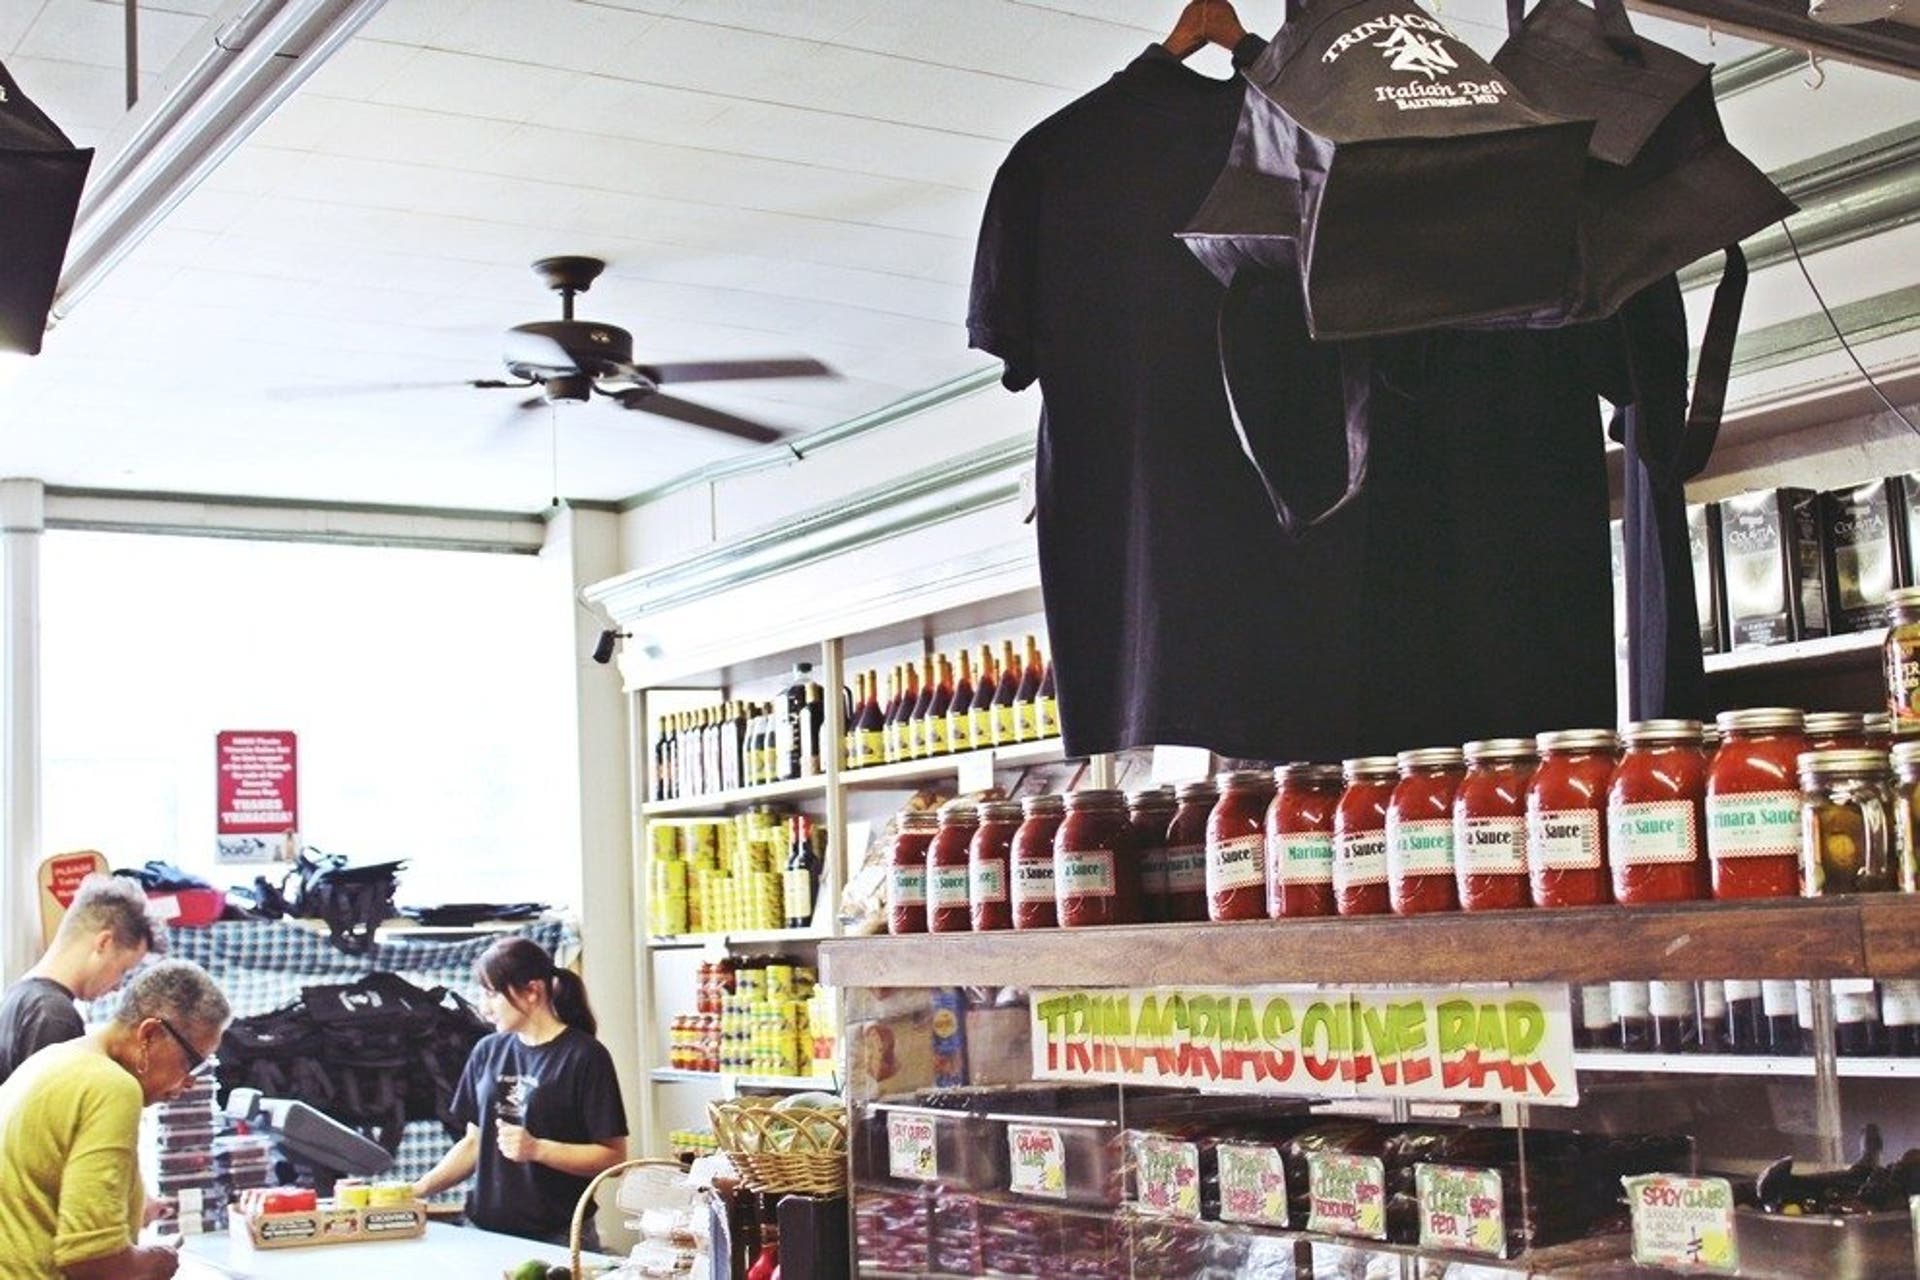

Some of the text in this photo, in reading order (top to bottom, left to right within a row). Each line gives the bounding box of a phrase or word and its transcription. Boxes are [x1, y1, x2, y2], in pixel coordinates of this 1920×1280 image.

[1375, 80, 1507, 101] Italian Deli
[1472, 94, 1499, 104] MD
[1545, 824, 1580, 839] Sauce
[1635, 818, 1674, 834] Sauce
[1409, 835, 1445, 851] Sauce
[1475, 830, 1511, 846] Sauce
[1222, 847, 1250, 864] Sauce
[1353, 841, 1385, 857] Sauce
[1026, 867, 1054, 880] Sauce
[1071, 863, 1099, 876] Sauce
[1037, 991, 1557, 1097] TRINACRIAS OLIVE BAR
[1642, 1185, 1681, 1208] SPICY
